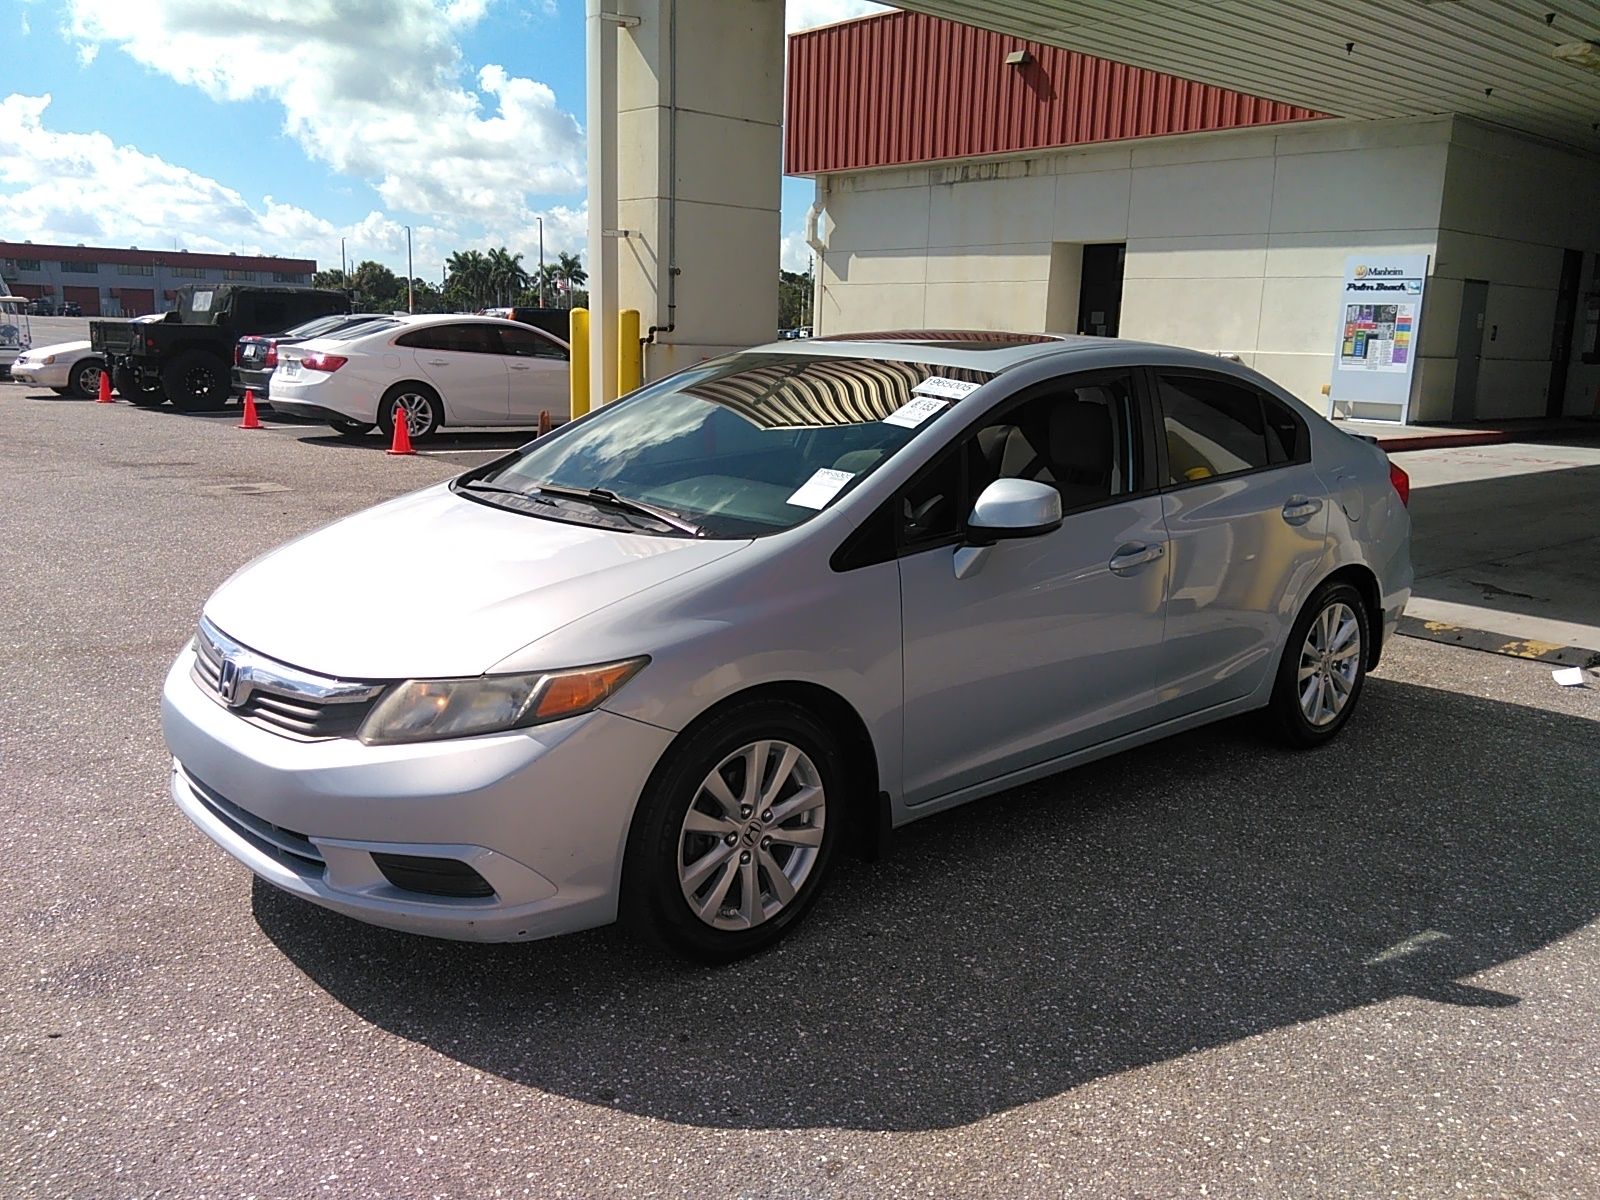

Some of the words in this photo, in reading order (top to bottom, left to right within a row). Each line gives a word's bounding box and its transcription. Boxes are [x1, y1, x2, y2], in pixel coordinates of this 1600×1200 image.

[1368, 267, 1403, 276] Manheim
[1346, 283, 1374, 291] Palm
[1375, 283, 1407, 291] Beach
